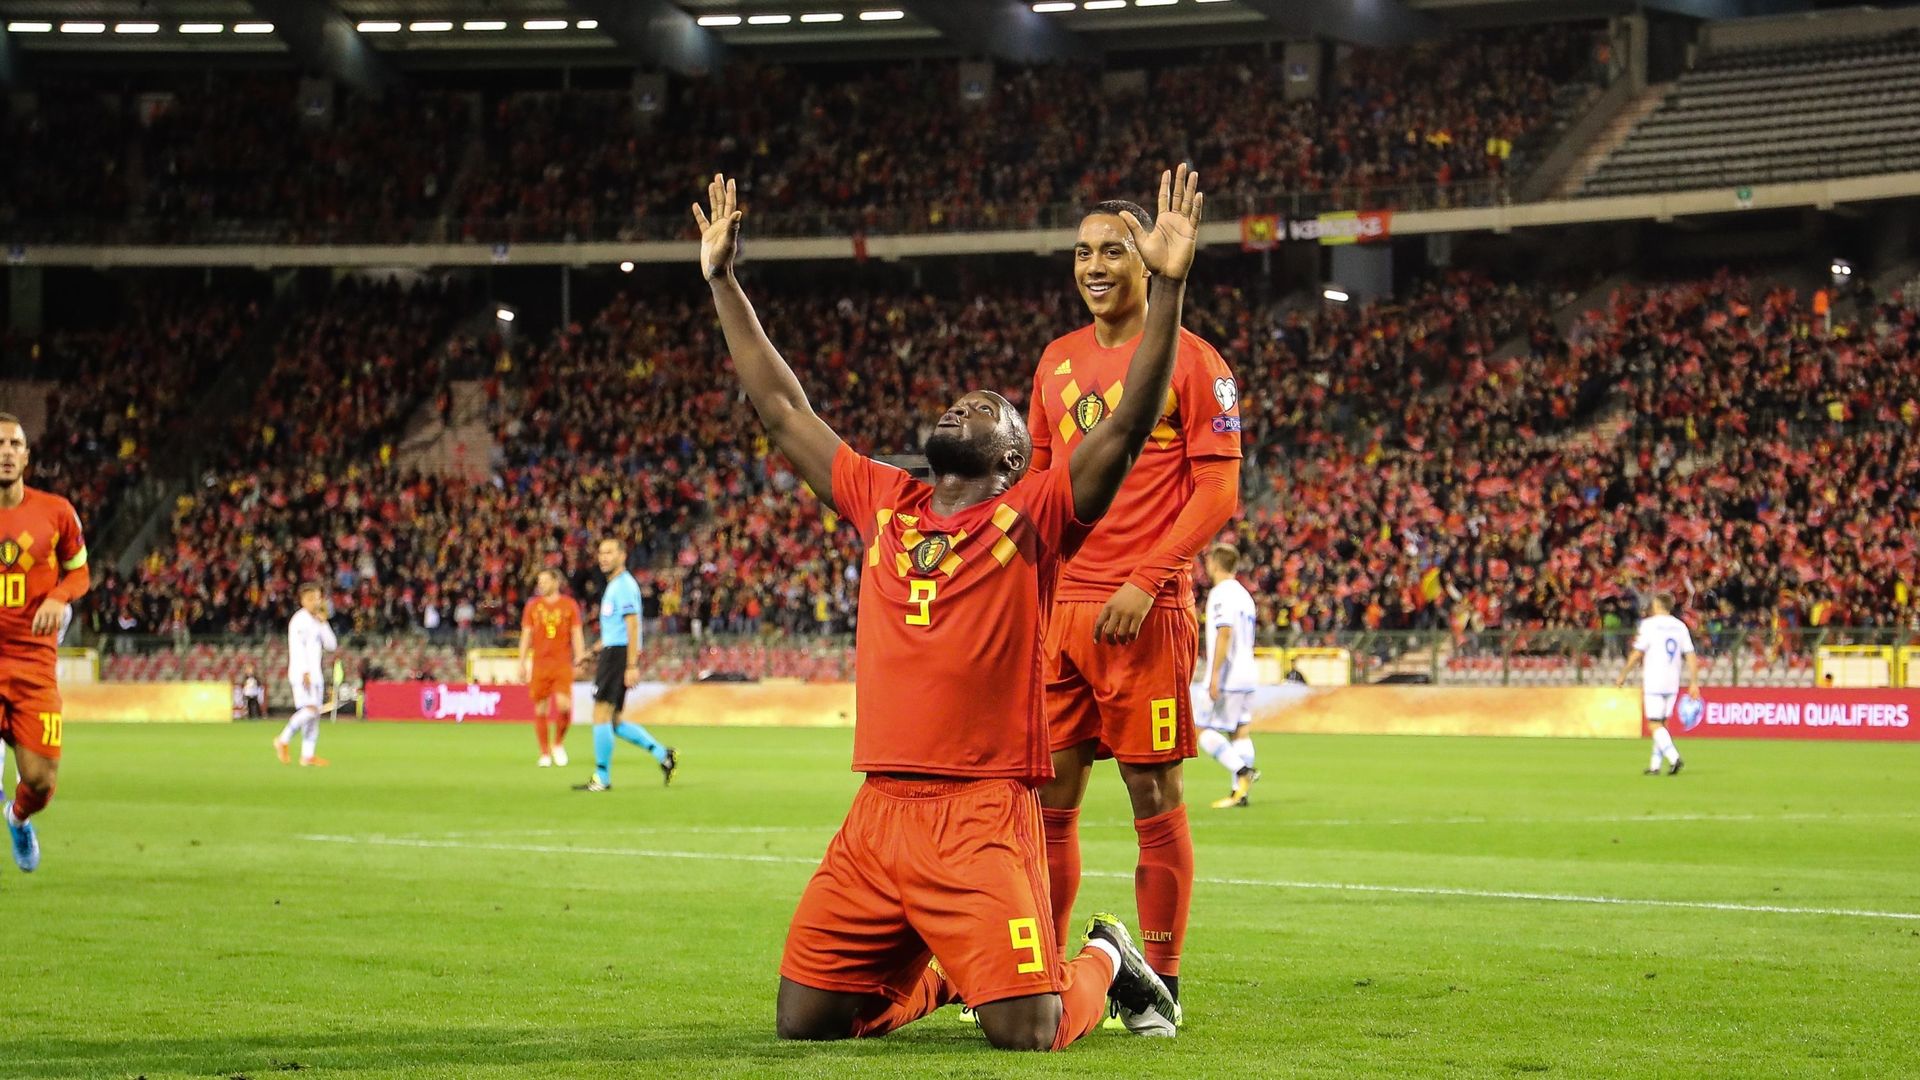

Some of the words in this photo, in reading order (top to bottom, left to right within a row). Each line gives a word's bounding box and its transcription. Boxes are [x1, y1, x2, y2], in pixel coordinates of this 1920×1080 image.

[906, 580, 937, 625] 9
[1665, 638, 1677, 664] 9
[39, 712, 62, 747] 10
[1151, 697, 1176, 751] 8
[1706, 702, 1800, 725] EUROPEAN
[1804, 703, 1910, 727] QUALIFIERS
[1008, 917, 1044, 974] 9
